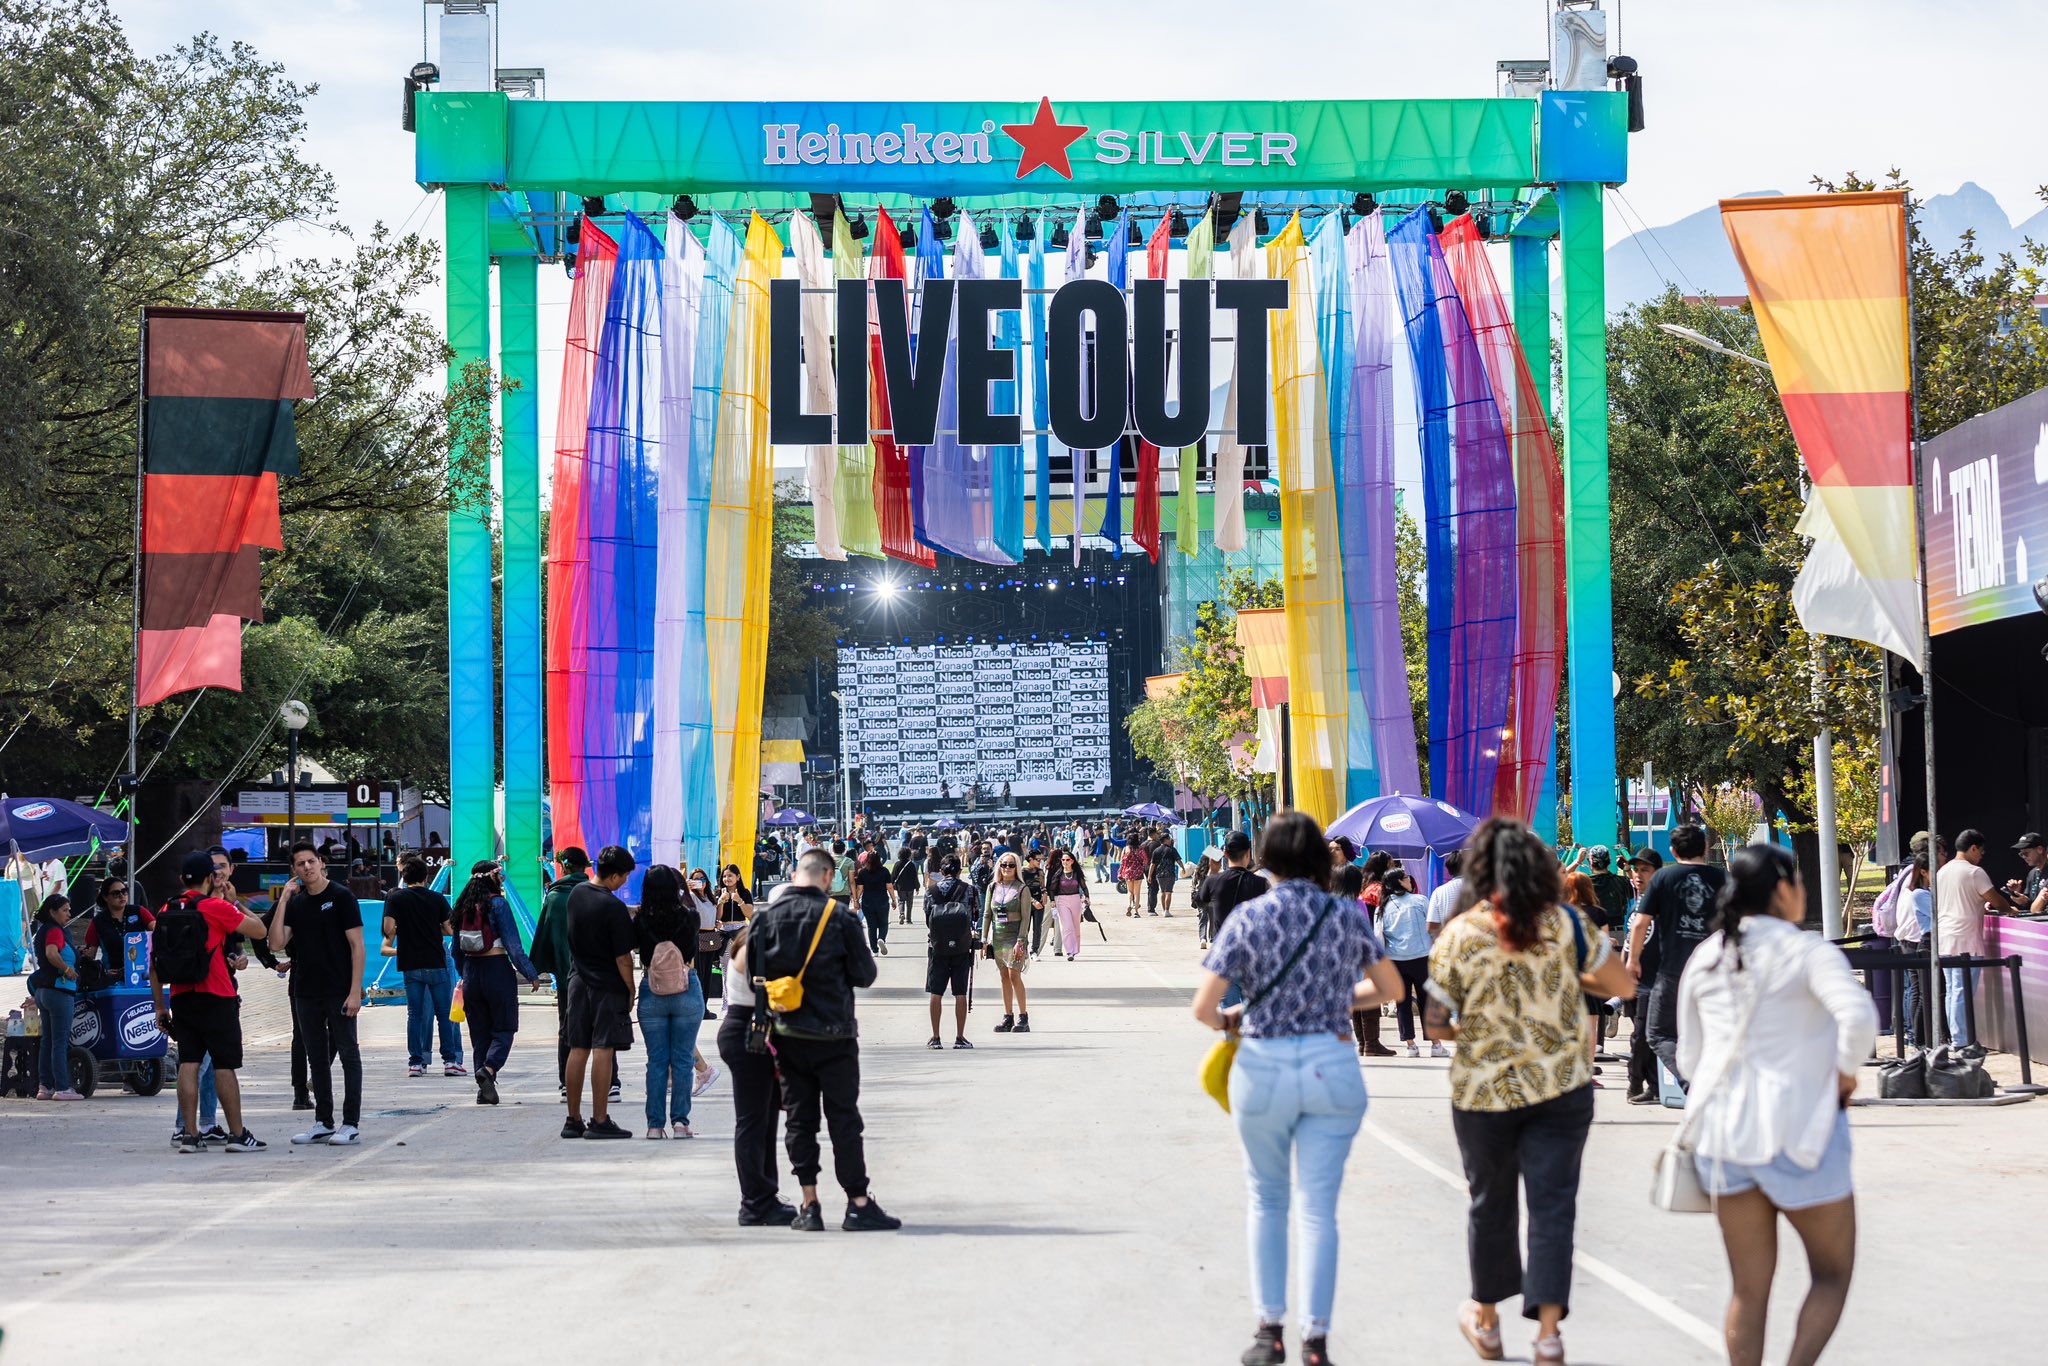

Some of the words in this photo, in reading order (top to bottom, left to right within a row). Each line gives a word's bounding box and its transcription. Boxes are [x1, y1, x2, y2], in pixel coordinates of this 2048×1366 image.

[1095, 129, 1298, 168] SILVER
[770, 278, 1023, 446] LIVE
[1047, 278, 1289, 450] OUT
[862, 651, 894, 660] Nicole
[940, 649, 972, 658] Nicole
[858, 663, 895, 673] Zignago
[901, 662, 934, 671] Nicole
[936, 661, 973, 671] Zignago
[978, 660, 1011, 669] Nicole
[1013, 659, 1050, 669] Zignago
[862, 674, 895, 683] Nicole
[897, 674, 934, 683] Zignago
[940, 672, 972, 681] Nicole
[974, 672, 1011, 681] Zignago
[1017, 670, 1050, 679] Nicole
[858, 686, 895, 696] Zignago
[901, 685, 934, 694] Nicole
[936, 684, 973, 694] Zignago
[979, 682, 1012, 691] Nicole
[1014, 682, 1051, 692] Zignago
[863, 697, 895, 706] Nicole
[898, 696, 935, 706] Zignago
[941, 695, 974, 704] Nicole
[975, 694, 1012, 704] Zignago
[1018, 693, 1052, 702] Nicole
[860, 708, 896, 718] Zignago
[902, 707, 935, 716] Nicole
[937, 706, 974, 716] Zignago
[980, 705, 1013, 714] Nicole
[1015, 704, 1052, 714] Zignago
[864, 719, 896, 728] Nicole
[898, 718, 935, 728] Zignago
[941, 717, 974, 726] Nicole
[976, 717, 1013, 726] Zignago
[1019, 715, 1052, 724] Nicole
[860, 731, 897, 741] Zignago
[903, 730, 936, 738] Nicole
[938, 729, 975, 738] Zignago
[981, 728, 1013, 736] Nicole
[1016, 727, 1052, 736] Zignago
[865, 742, 897, 750] Nicole
[900, 741, 936, 751] Zignago
[942, 740, 976, 749] Nicole
[977, 739, 1014, 748] Zignago
[1020, 738, 1052, 747] Nicole
[860, 753, 897, 763] Zignago
[904, 752, 937, 761] Nicole
[939, 751, 976, 761] Zignago
[982, 750, 1015, 759] Nicole
[1017, 749, 1054, 759] Zignago
[904, 775, 937, 783] Nicole
[983, 773, 1015, 781] Nicole
[866, 787, 898, 796] Nicole
[900, 786, 937, 796] Zignago
[126, 1004, 152, 1019] HELADOS
